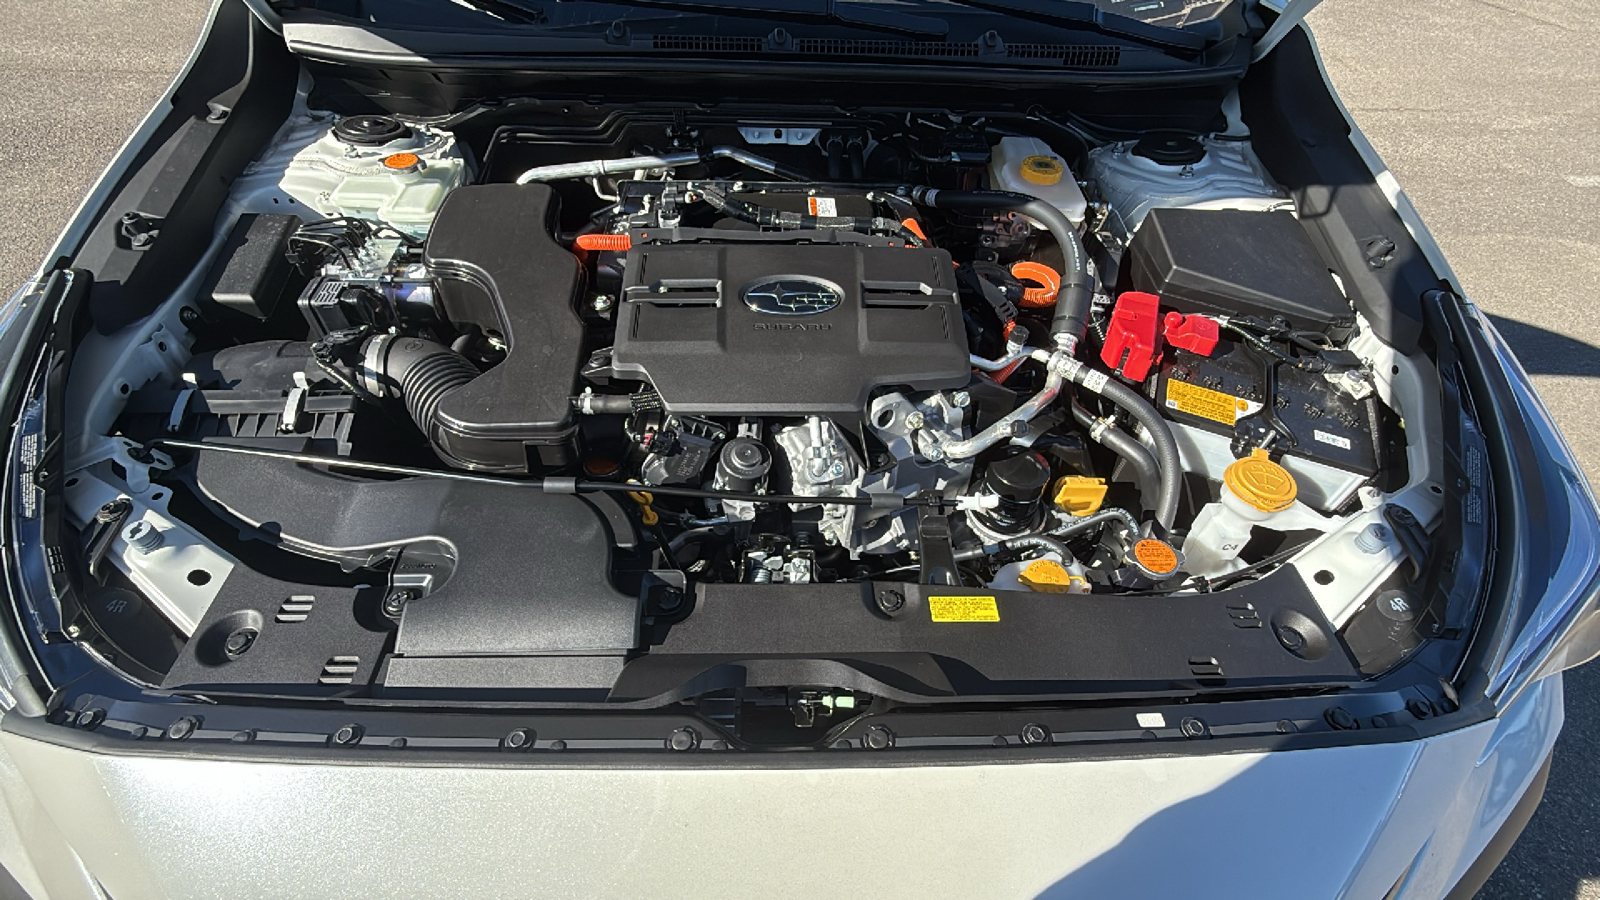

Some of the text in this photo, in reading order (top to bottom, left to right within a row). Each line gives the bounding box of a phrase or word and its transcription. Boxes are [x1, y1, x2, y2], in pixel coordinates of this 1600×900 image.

[753, 322, 833, 331] SUBARU
[106, 599, 127, 613] 4R
[1390, 597, 1410, 612] 4R
